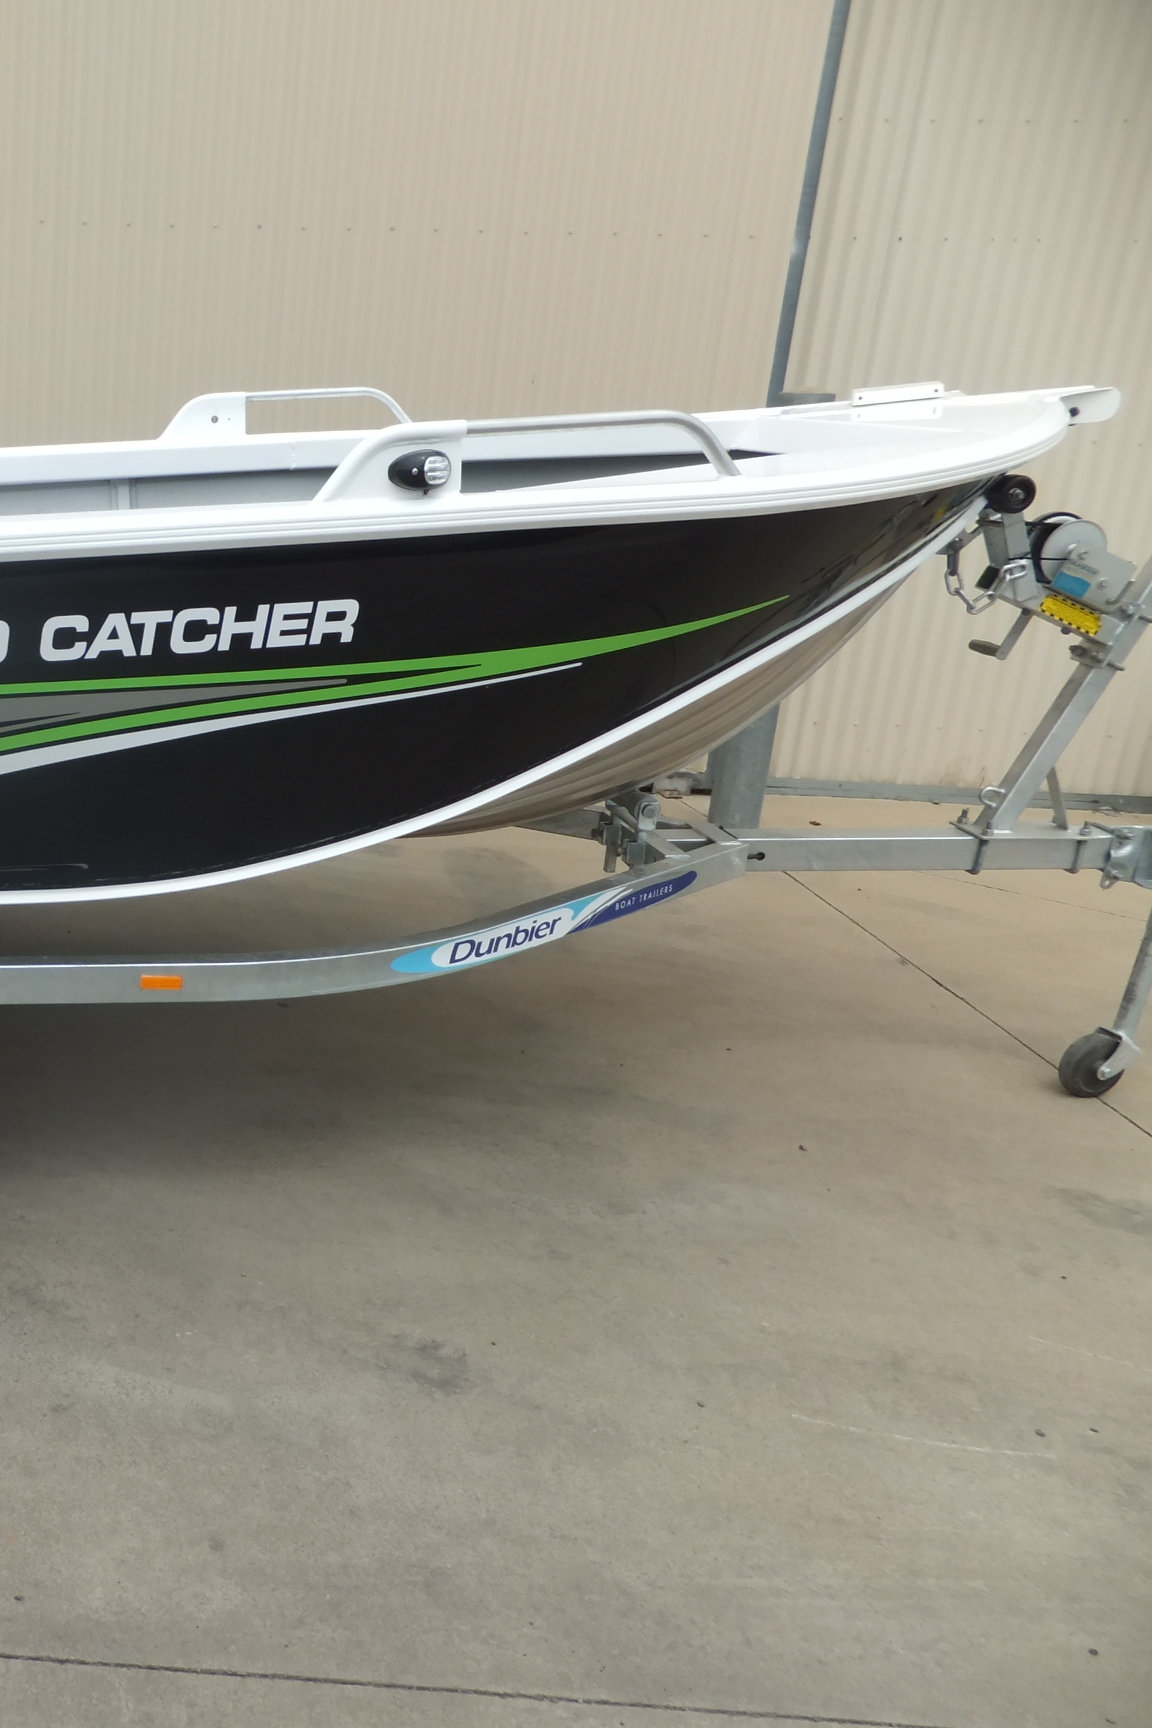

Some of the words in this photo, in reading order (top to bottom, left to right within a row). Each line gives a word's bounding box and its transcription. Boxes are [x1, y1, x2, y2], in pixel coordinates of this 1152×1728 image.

[39, 599, 360, 662] CATCHER
[614, 896, 637, 911] BOAT
[639, 884, 674, 903] TRAILERS
[448, 917, 562, 965] Dunbier
